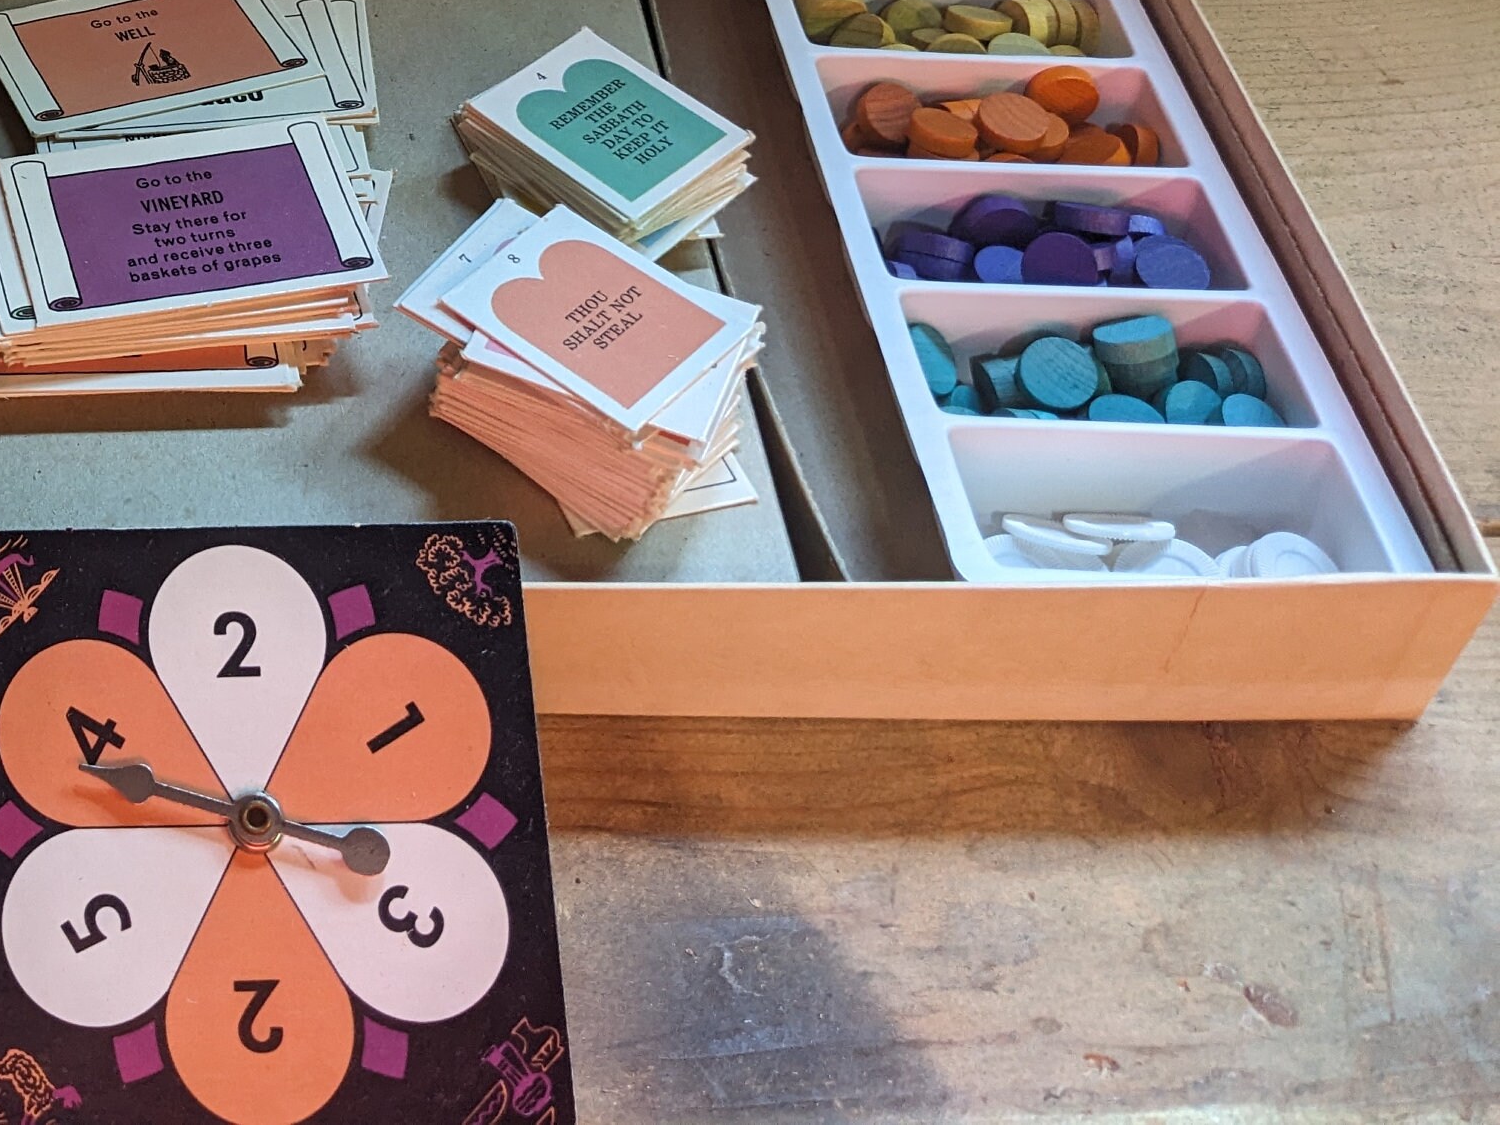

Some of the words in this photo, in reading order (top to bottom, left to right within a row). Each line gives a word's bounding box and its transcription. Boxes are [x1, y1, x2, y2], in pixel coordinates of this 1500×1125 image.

[90, 18, 111, 30] Go
[116, 13, 131, 24] to
[134, 8, 158, 20] the
[114, 25, 155, 44] WELL
[536, 72, 547, 81] 4
[549, 78, 626, 131] REMEMBER
[584, 102, 617, 125] THE
[582, 100, 647, 145] SABBATH
[601, 124, 635, 150] DAY
[632, 113, 654, 131] TO
[612, 133, 652, 162] KEEP
[652, 119, 670, 138] IT
[634, 136, 674, 165] HOLY
[135, 176, 160, 190] Go
[164, 174, 181, 186] to
[184, 169, 212, 183] the
[140, 190, 224, 214] VINEYARD
[132, 221, 170, 236] Stay
[175, 214, 218, 230] there
[223, 209, 247, 223] for
[154, 233, 185, 248] two
[190, 227, 236, 243] turns
[127, 253, 158, 267] and
[163, 244, 225, 263] receive
[229, 237, 273, 253] three
[129, 265, 197, 283] baskets
[202, 258, 219, 274] of
[224, 252, 281, 273] grapes
[459, 254, 472, 265] 7
[507, 253, 521, 265] 8
[562, 310, 614, 352] SHALT
[609, 285, 643, 315] NOT
[564, 290, 609, 324] THOU
[592, 310, 643, 350] STEAL
[212, 611, 262, 678] 2
[66, 705, 126, 767] 4
[366, 701, 426, 754] 1
[60, 893, 132, 954] 5
[378, 885, 444, 949] 3
[232, 979, 284, 1054] 2
